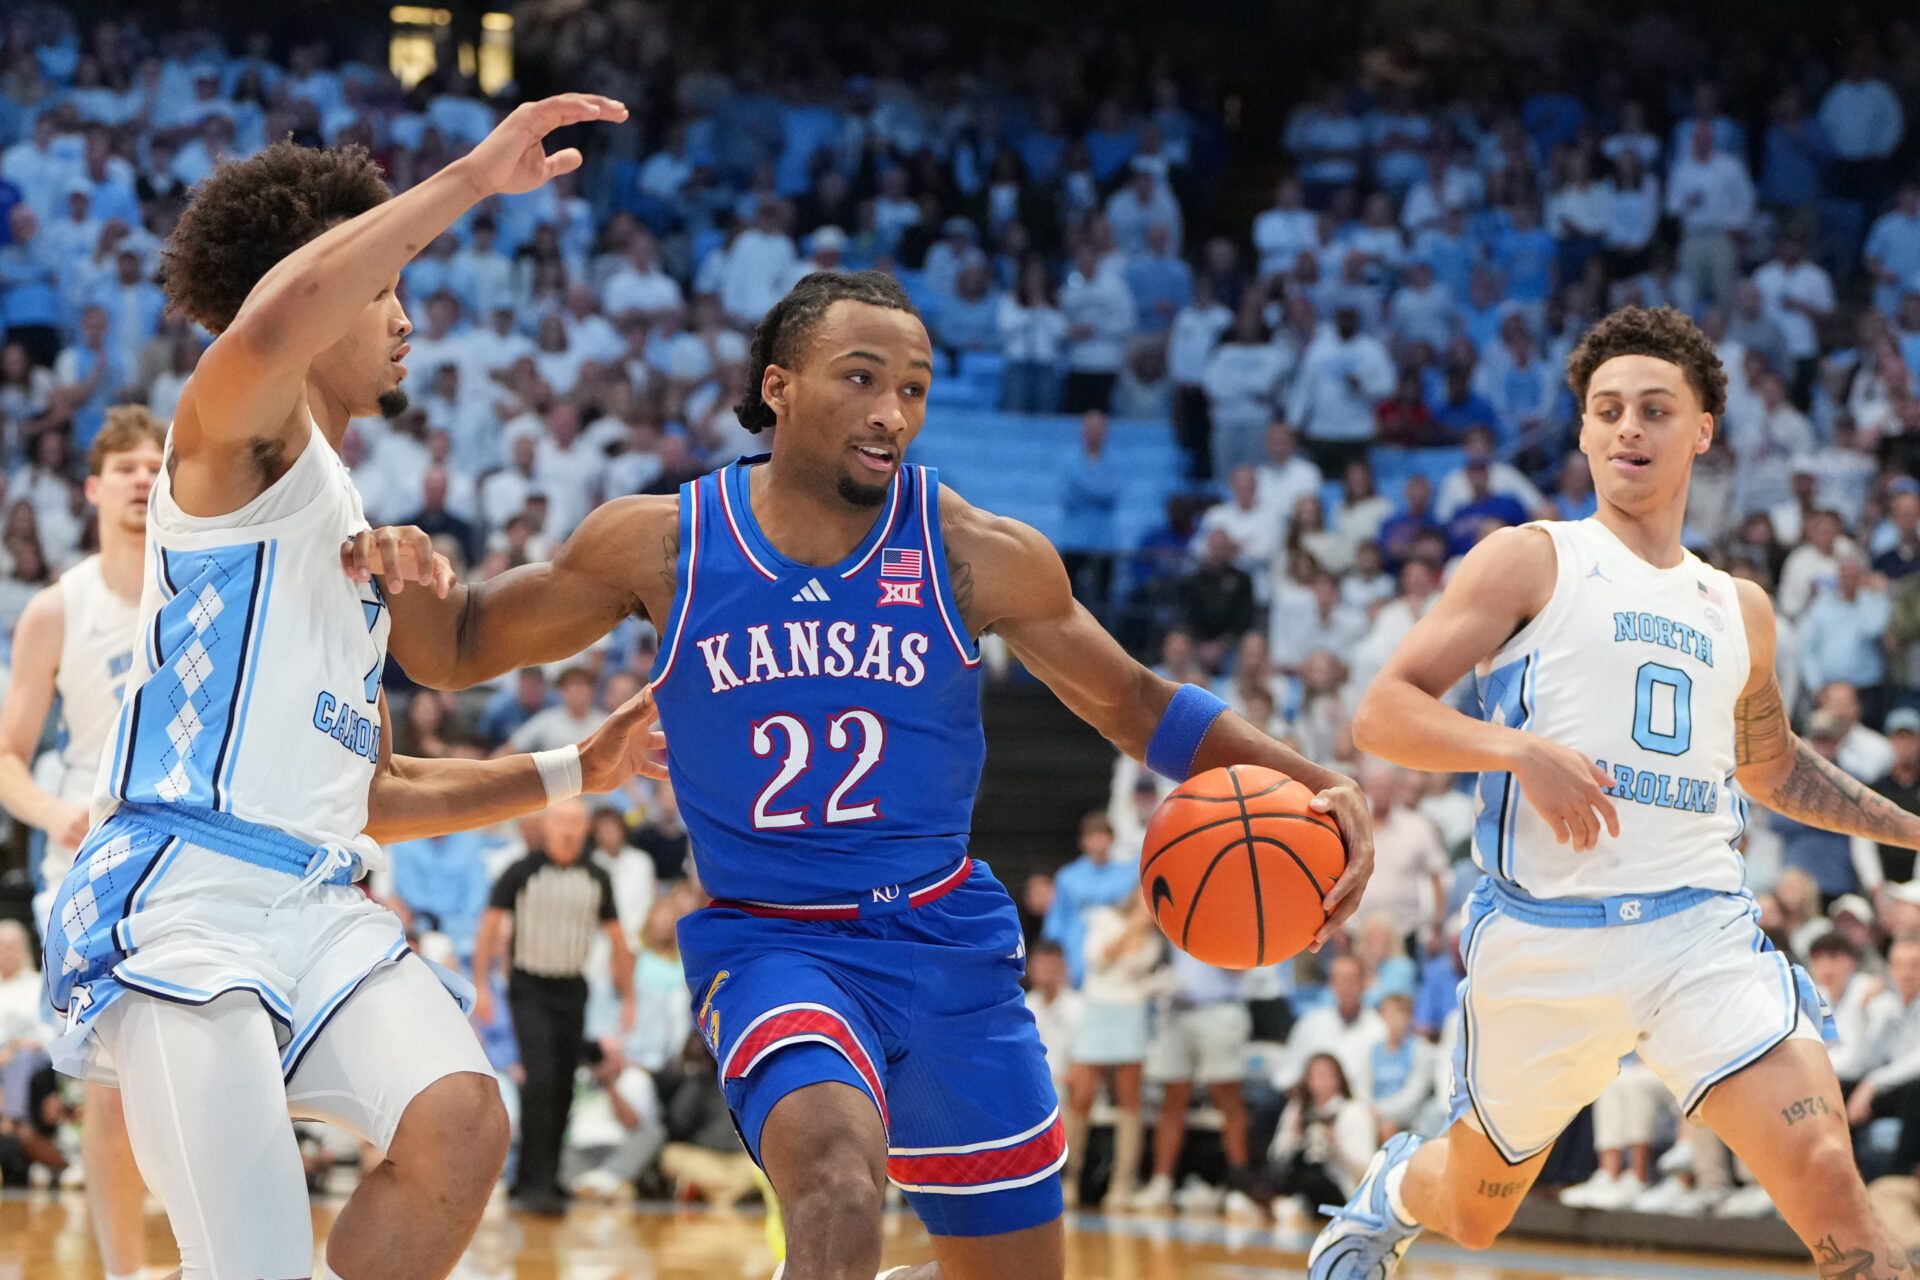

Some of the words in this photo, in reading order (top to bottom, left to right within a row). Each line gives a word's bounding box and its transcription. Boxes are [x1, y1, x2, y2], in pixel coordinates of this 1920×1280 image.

[696, 619, 929, 694] KANSAS
[1613, 612, 1713, 668] NORTH
[1631, 661, 1692, 757] 0
[750, 706, 885, 831] 22
[872, 883, 900, 903] KU
